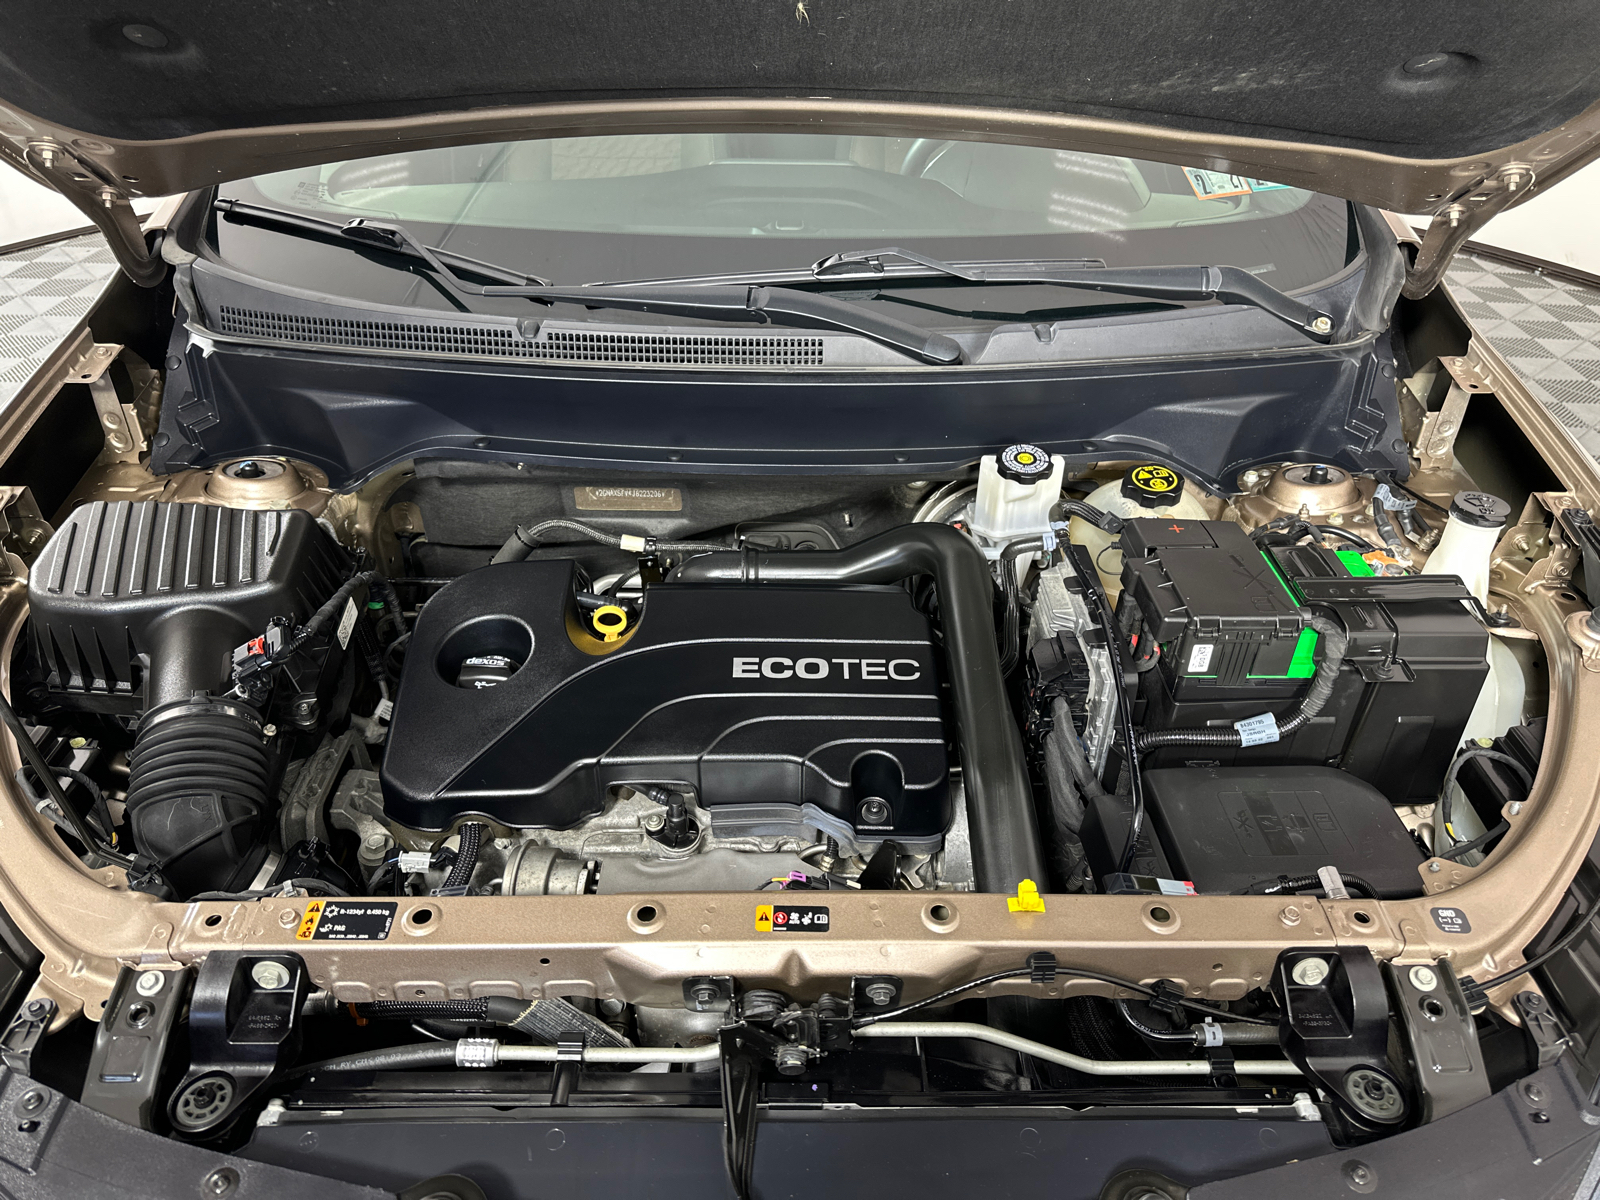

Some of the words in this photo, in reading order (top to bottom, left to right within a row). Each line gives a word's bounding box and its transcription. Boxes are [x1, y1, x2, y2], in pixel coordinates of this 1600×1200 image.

[465, 657, 505, 666] dexos
[732, 656, 921, 681] ECOTEC
[1437, 909, 1456, 917] GND
